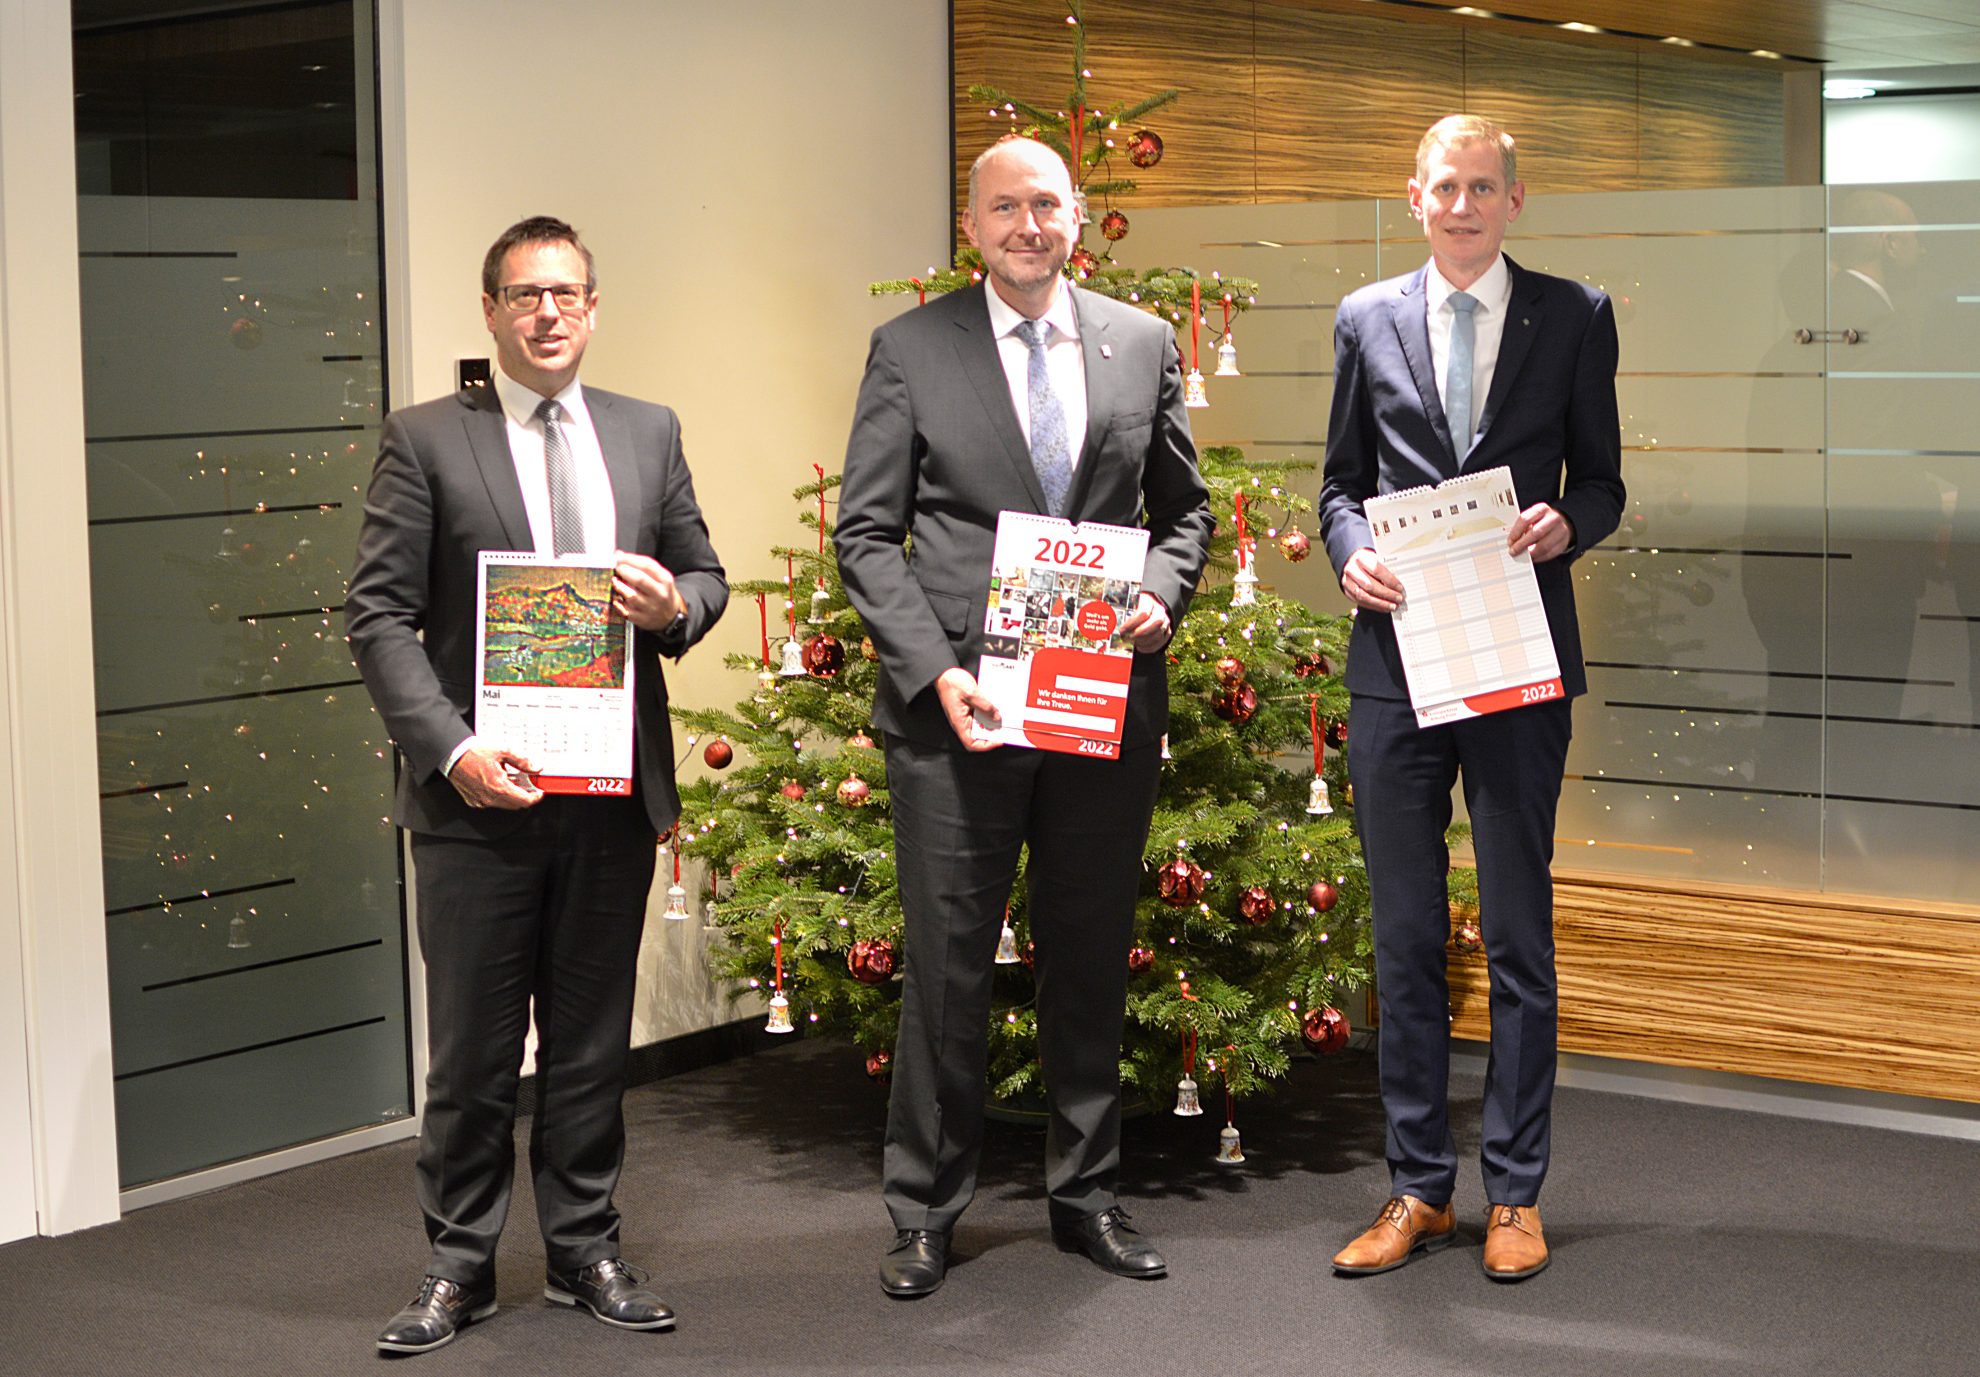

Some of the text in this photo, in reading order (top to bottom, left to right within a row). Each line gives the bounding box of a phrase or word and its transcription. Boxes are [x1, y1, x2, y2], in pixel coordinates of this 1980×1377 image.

[1034, 538, 1106, 569] 2022
[1083, 622, 1095, 630] Geld
[482, 690, 501, 699] Mai
[1038, 688, 1107, 706] Wir danken Ihnen für
[1520, 683, 1557, 703] 2022
[1037, 698, 1073, 711] Ihre Treue.
[1078, 739, 1114, 756] 2022
[587, 778, 625, 793] 2022
